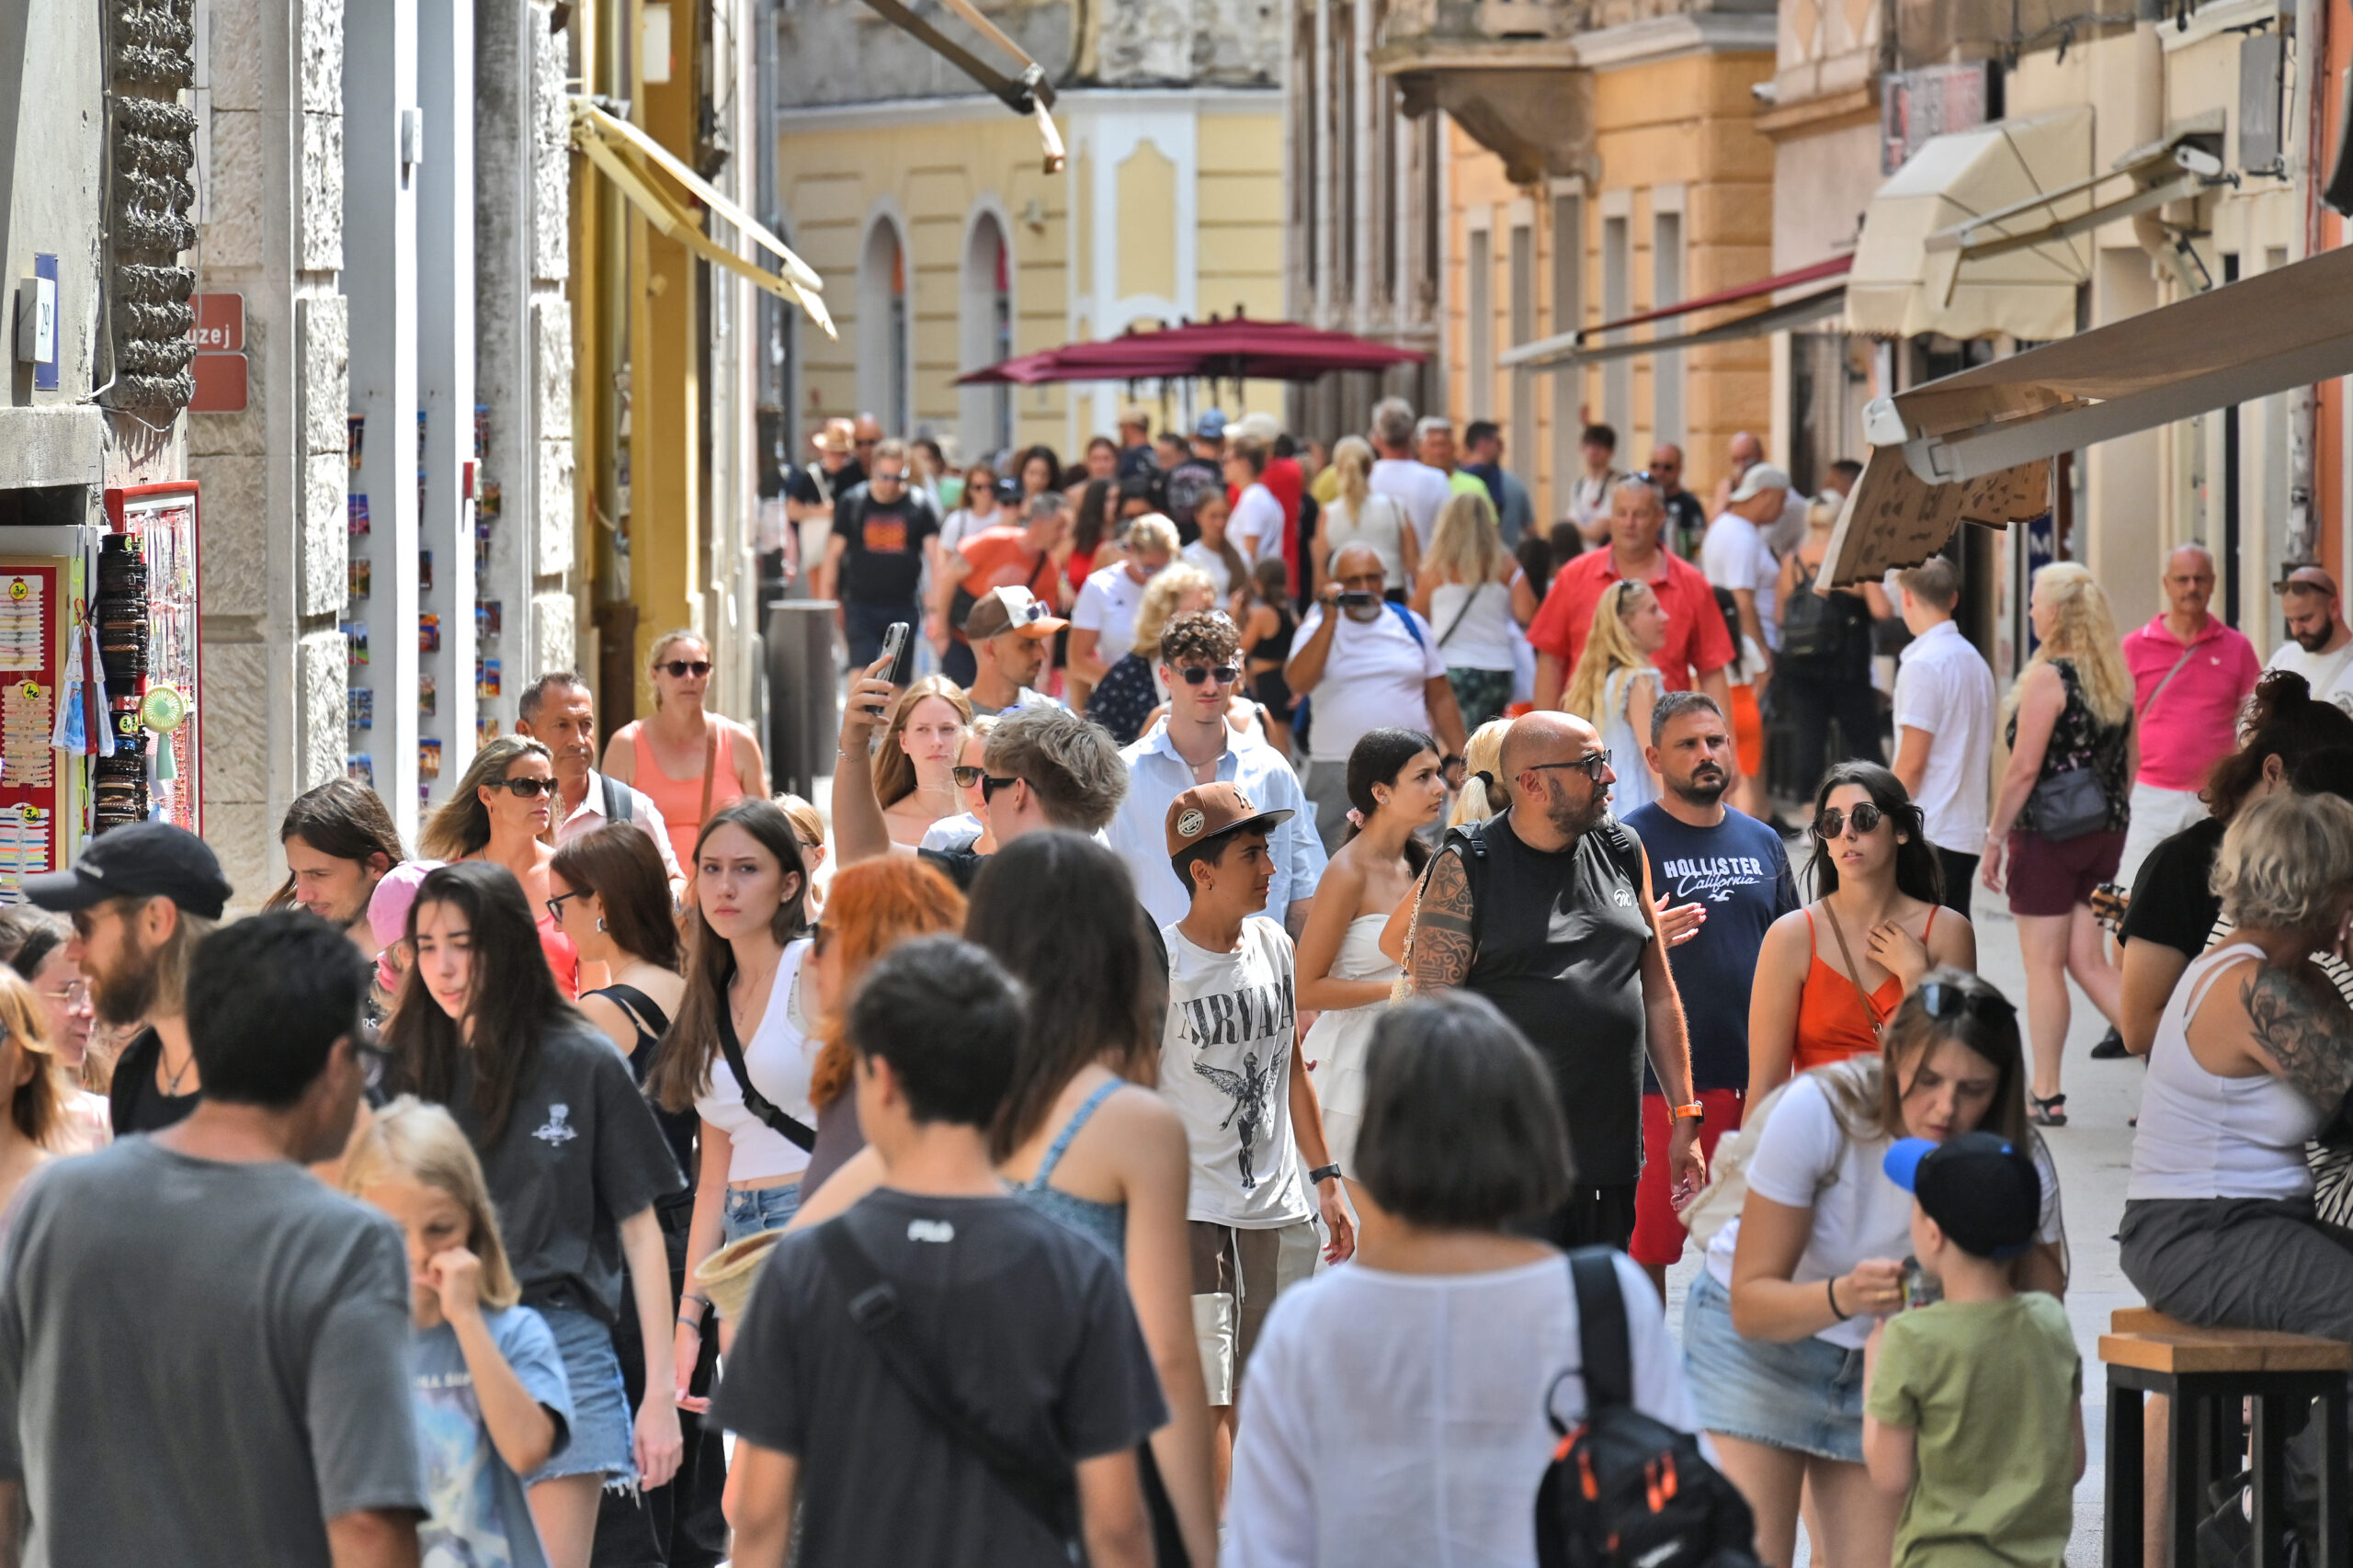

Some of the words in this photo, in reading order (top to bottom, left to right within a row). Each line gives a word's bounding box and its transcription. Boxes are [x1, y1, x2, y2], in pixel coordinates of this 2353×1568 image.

[187, 324, 230, 349] uzej
[1663, 858, 1764, 879] HOLLISTER
[1677, 873, 1760, 898] California
